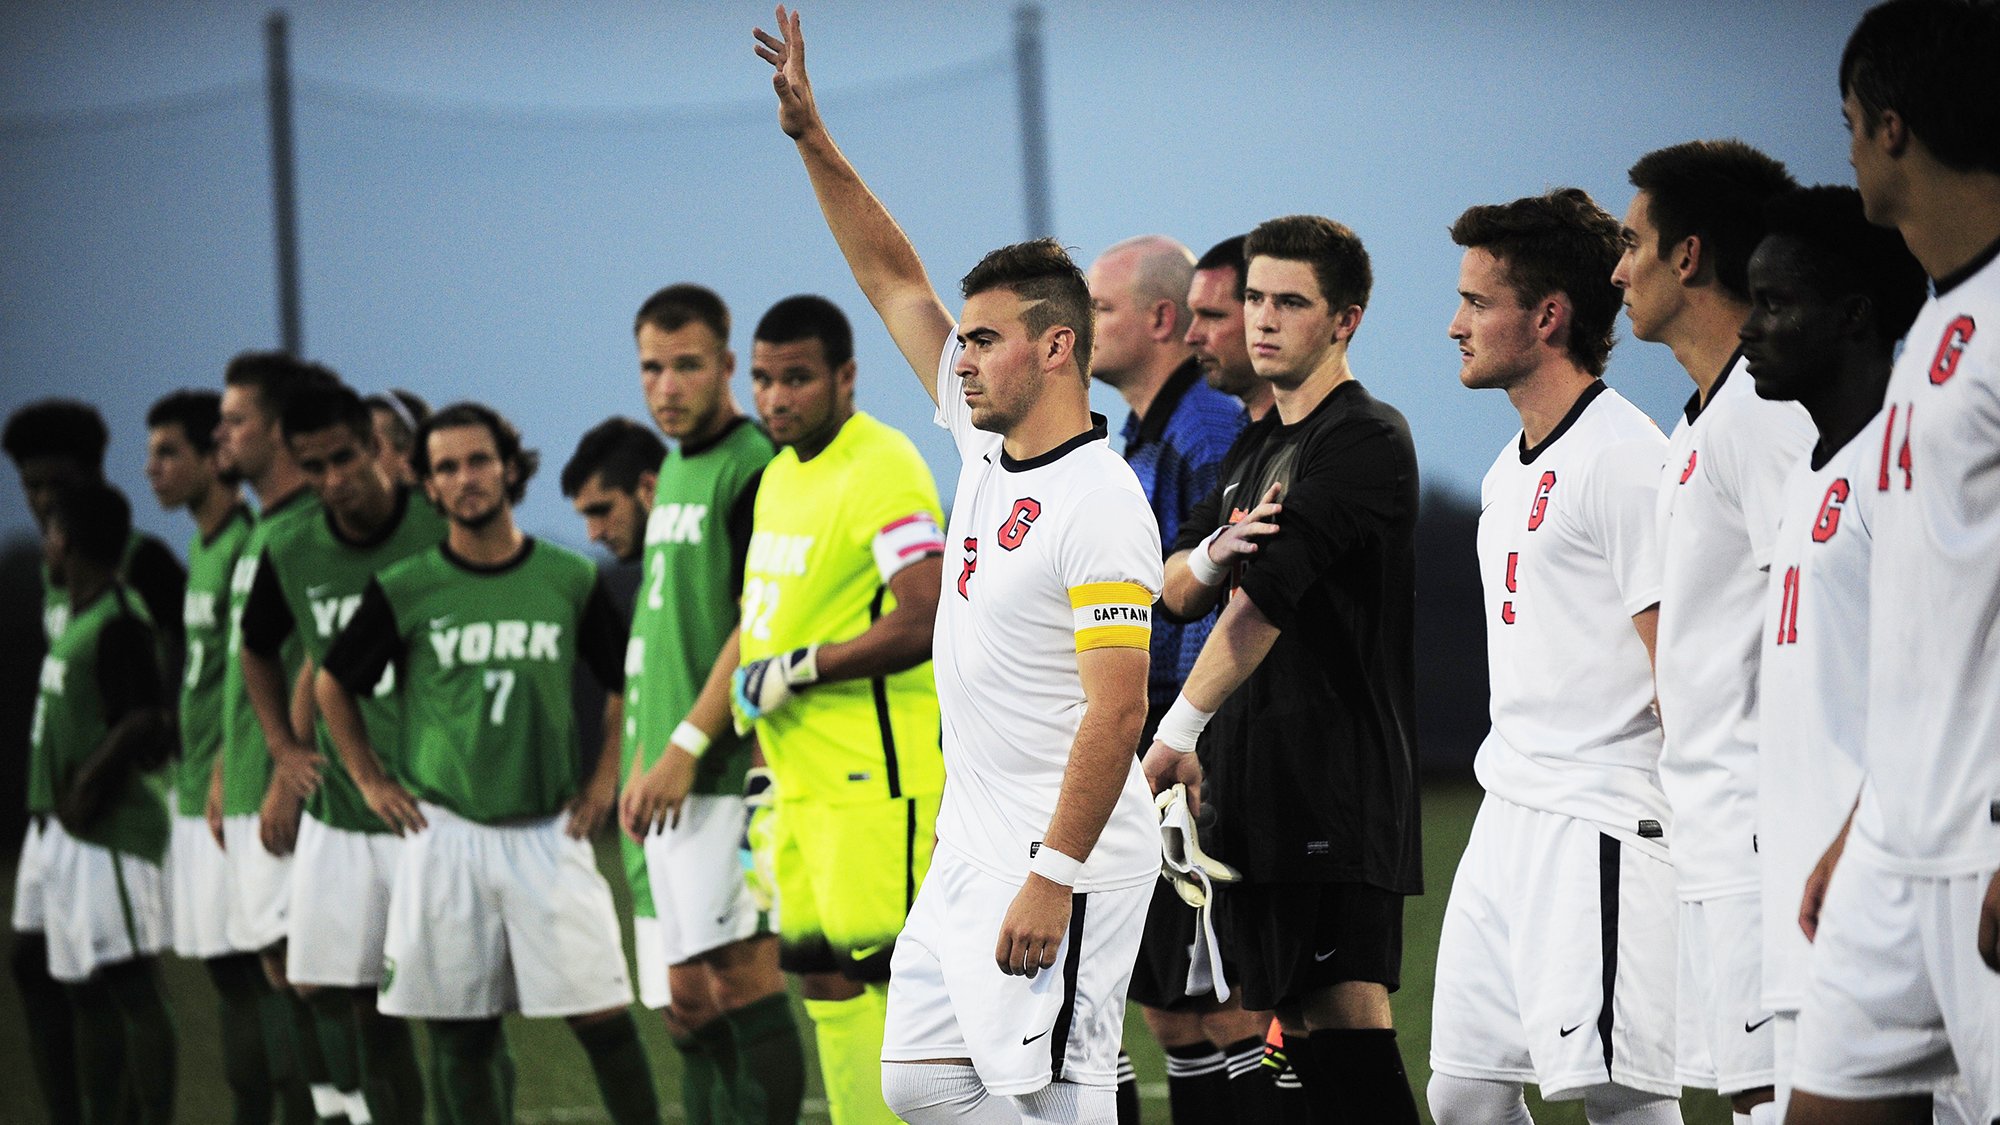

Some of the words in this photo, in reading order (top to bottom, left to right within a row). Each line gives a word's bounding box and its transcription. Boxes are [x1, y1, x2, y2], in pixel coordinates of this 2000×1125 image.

[1929, 314, 1976, 385] G
[997, 497, 1041, 552] G
[1528, 471, 1557, 531] G
[1812, 478, 1850, 543] G
[1094, 607, 1148, 622] CAPTAIN
[429, 620, 561, 669] YORK
[484, 669, 515, 725] 7
